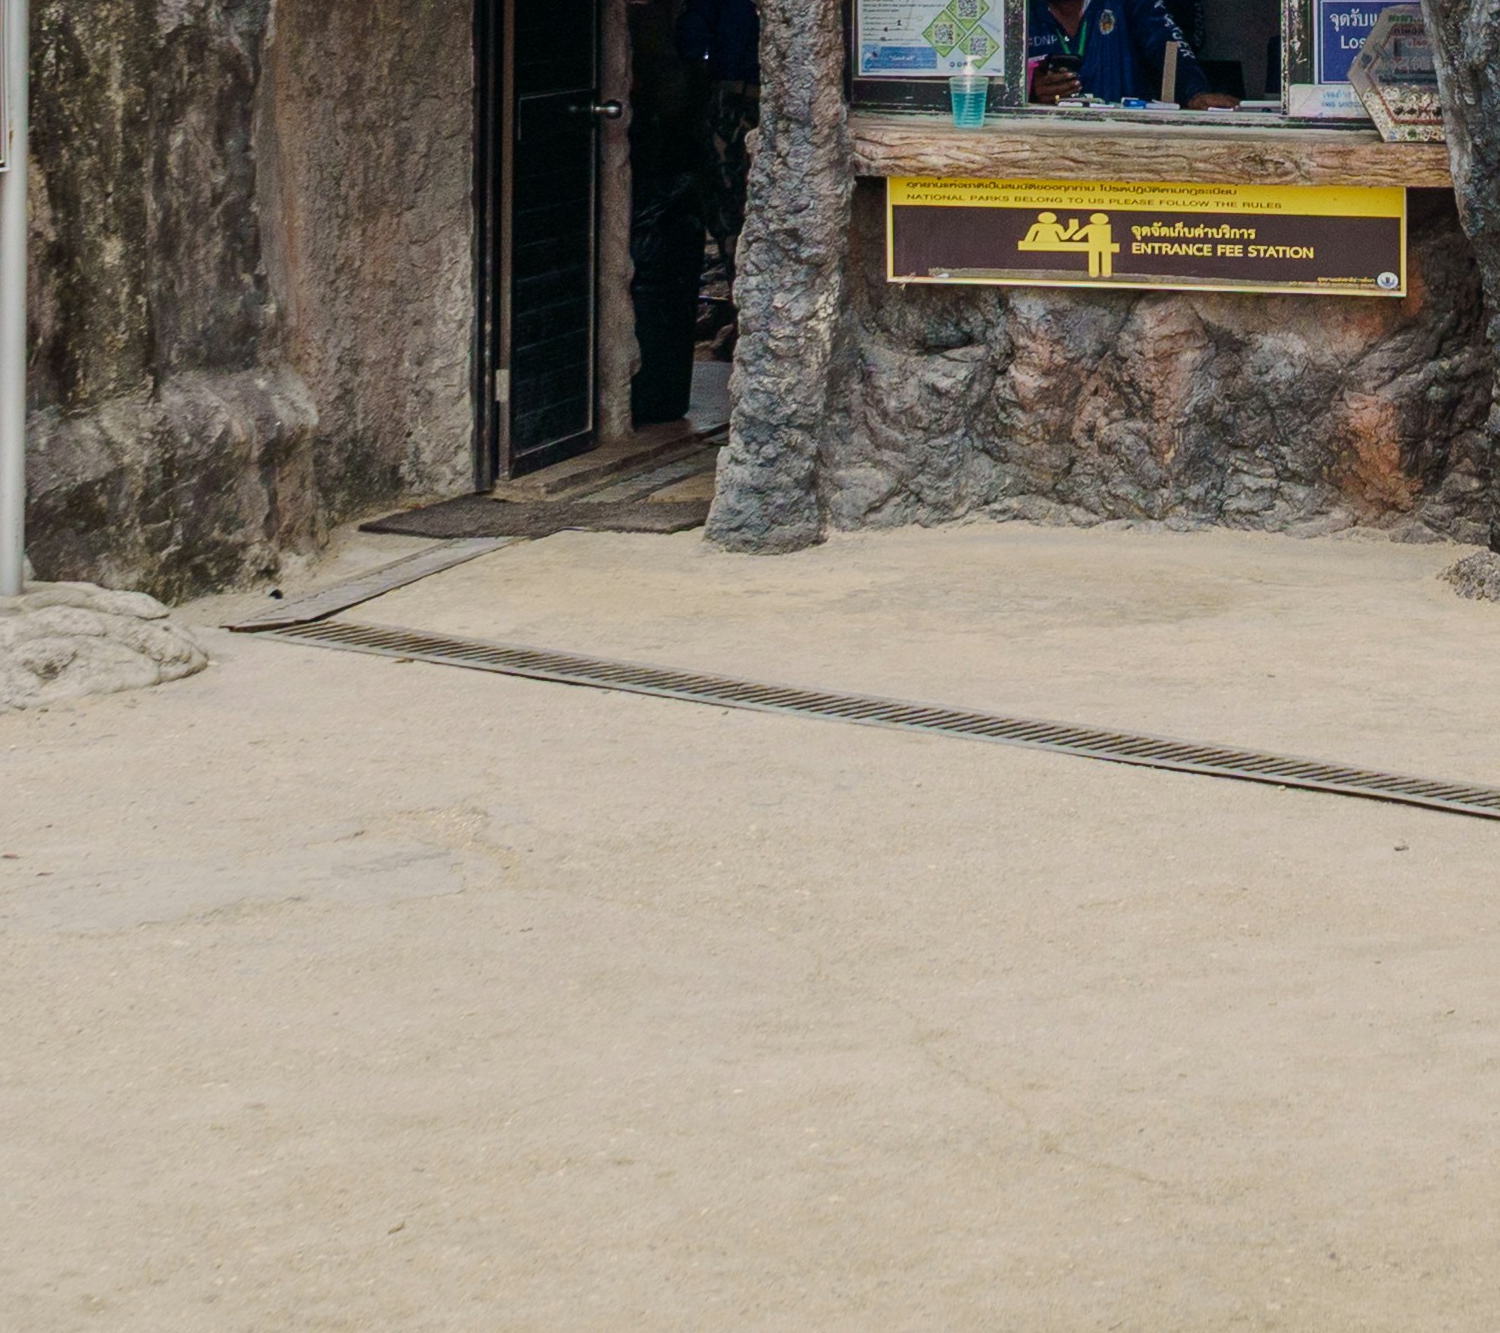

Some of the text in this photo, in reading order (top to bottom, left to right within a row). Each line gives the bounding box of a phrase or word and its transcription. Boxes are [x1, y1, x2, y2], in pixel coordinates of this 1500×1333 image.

[1340, 35, 1366, 50] Los
[906, 193, 1282, 209] NATIONAL PARKS BELONG TO US PLEASE FOLLOW THE RULES
[1131, 221, 1256, 241] จุดจัดเก็บค่าบริการ
[1131, 242, 1315, 259] ENTRANCE FEE STATION
